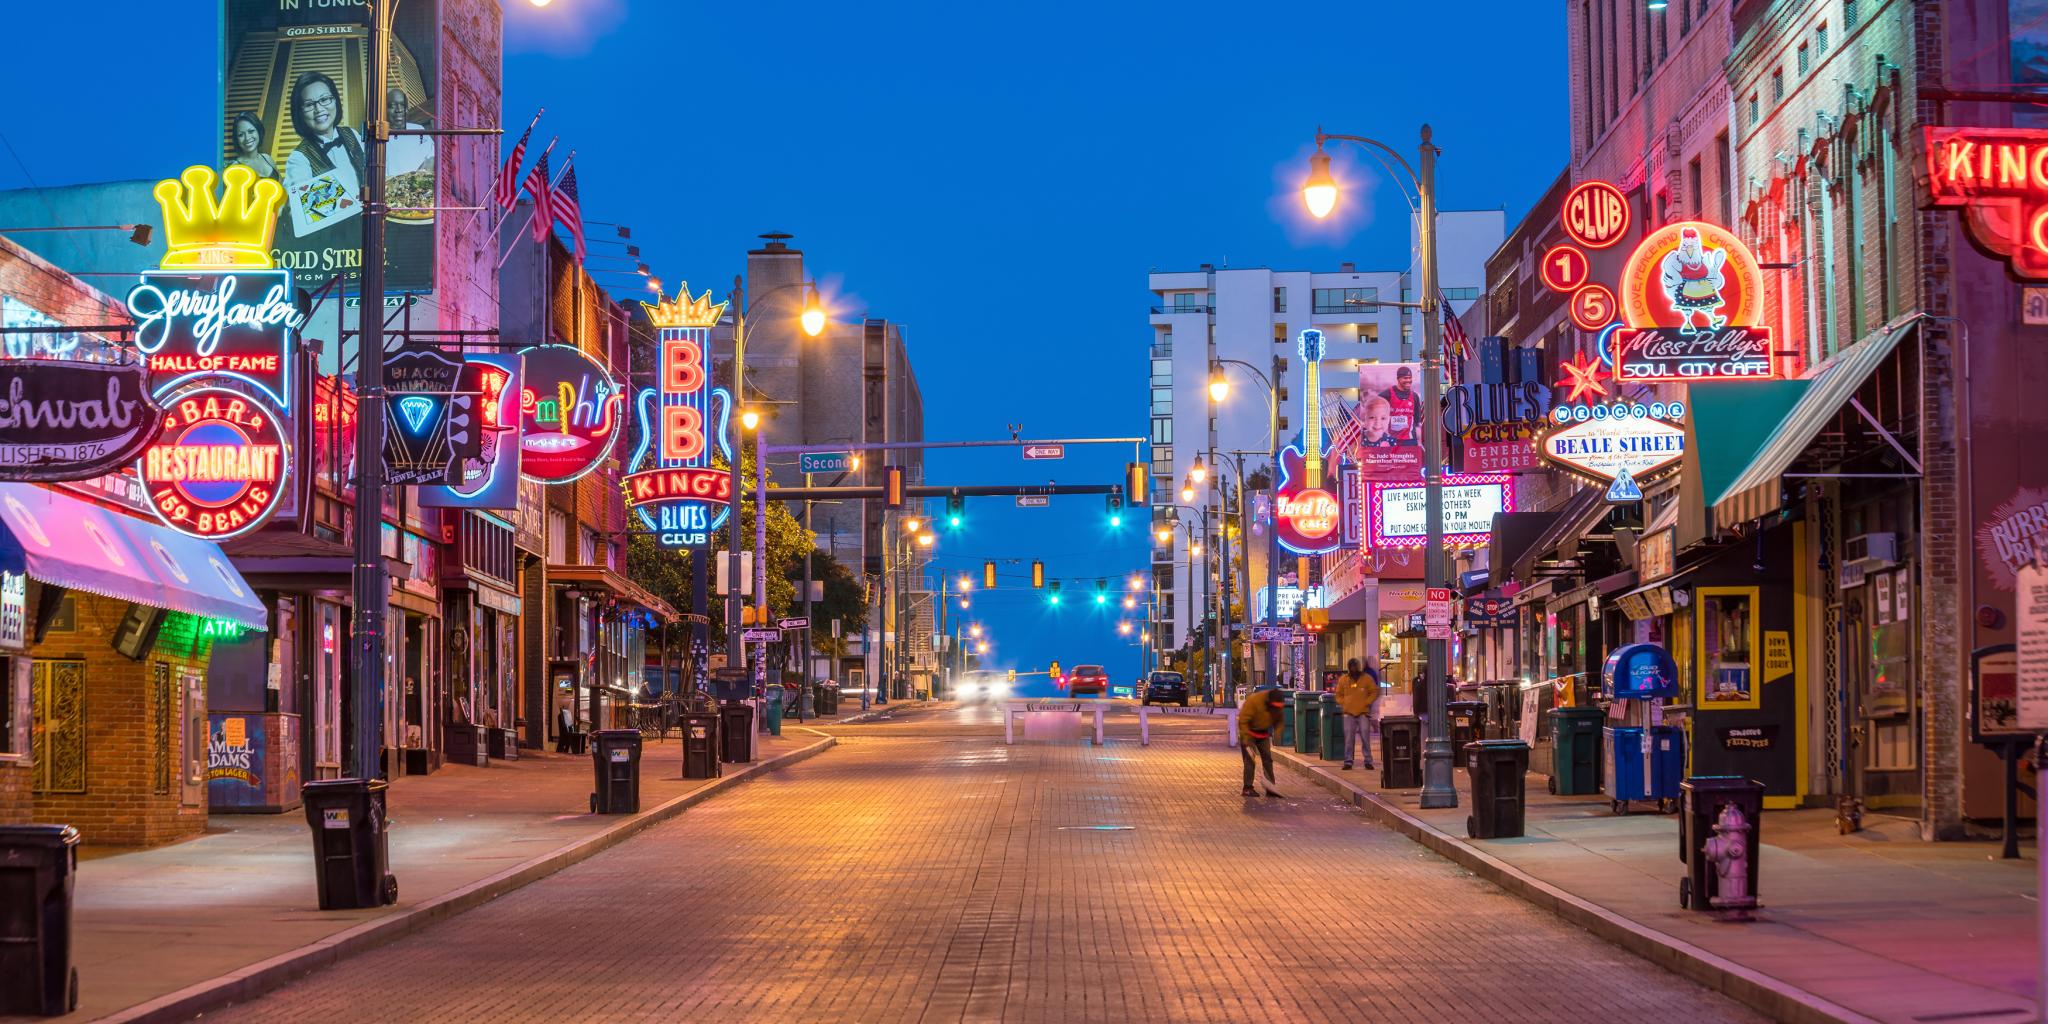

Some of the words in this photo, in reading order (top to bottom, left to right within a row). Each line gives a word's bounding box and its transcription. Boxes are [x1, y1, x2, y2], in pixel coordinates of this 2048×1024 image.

[287, 28, 315, 37] GOLD
[316, 26, 353, 35] STRIKE
[1570, 188, 1623, 241] CLUB
[1659, 232, 1678, 249] AND
[322, 248, 390, 272] STRI
[1710, 233, 1748, 272] CHICKEN
[1556, 253, 1573, 284] 1
[1583, 292, 1606, 322] 5
[127, 284, 214, 353] Jerry
[197, 275, 306, 357] Lawler
[1621, 330, 1686, 358] Miss
[152, 356, 195, 371] HALL
[201, 357, 223, 371] OF
[229, 357, 278, 370] FAME
[1623, 364, 1675, 377] SOUL
[1678, 362, 1717, 376] CITY
[1721, 361, 1770, 375] CAFE
[391, 367, 442, 379] BLACK
[181, 397, 247, 424] BAR
[522, 373, 625, 437] emphis
[1442, 380, 1541, 437] BLUES
[1557, 403, 1683, 421] WELCOME
[73, 443, 106, 461] 1876
[1469, 444, 1532, 458] GENERA
[1555, 438, 1613, 455] BEALE
[1620, 435, 1684, 452] STREET
[147, 444, 280, 482] RESTAURANT
[804, 456, 850, 469] Second
[1482, 456, 1530, 469] STORE
[390, 470, 417, 484] JEWEL
[415, 469, 444, 483] BEALE
[633, 474, 731, 500] KING'S
[1387, 492, 1401, 502] LIVE
[1403, 491, 1424, 501] MUSIC
[1458, 490, 1462, 499] A
[1464, 488, 1482, 498] WEEK
[198, 487, 271, 533] BEALE
[1406, 502, 1427, 511] ESKIM
[1443, 500, 1471, 510] OTHERS
[661, 505, 707, 530] BLUES
[1455, 511, 1468, 520] PM
[1390, 524, 1401, 533] PUT
[1403, 523, 1419, 533] SOME
[1451, 521, 1467, 531] YOUR
[1468, 520, 1491, 530] MOUTH
[661, 533, 707, 544] CLUB
[1431, 591, 1445, 600] NO
[204, 623, 237, 635] ATM
[1768, 638, 1786, 646] DOWN
[1768, 649, 1787, 657] HOME
[1726, 738, 1751, 747] FRIED
[225, 768, 249, 780] LAGER
